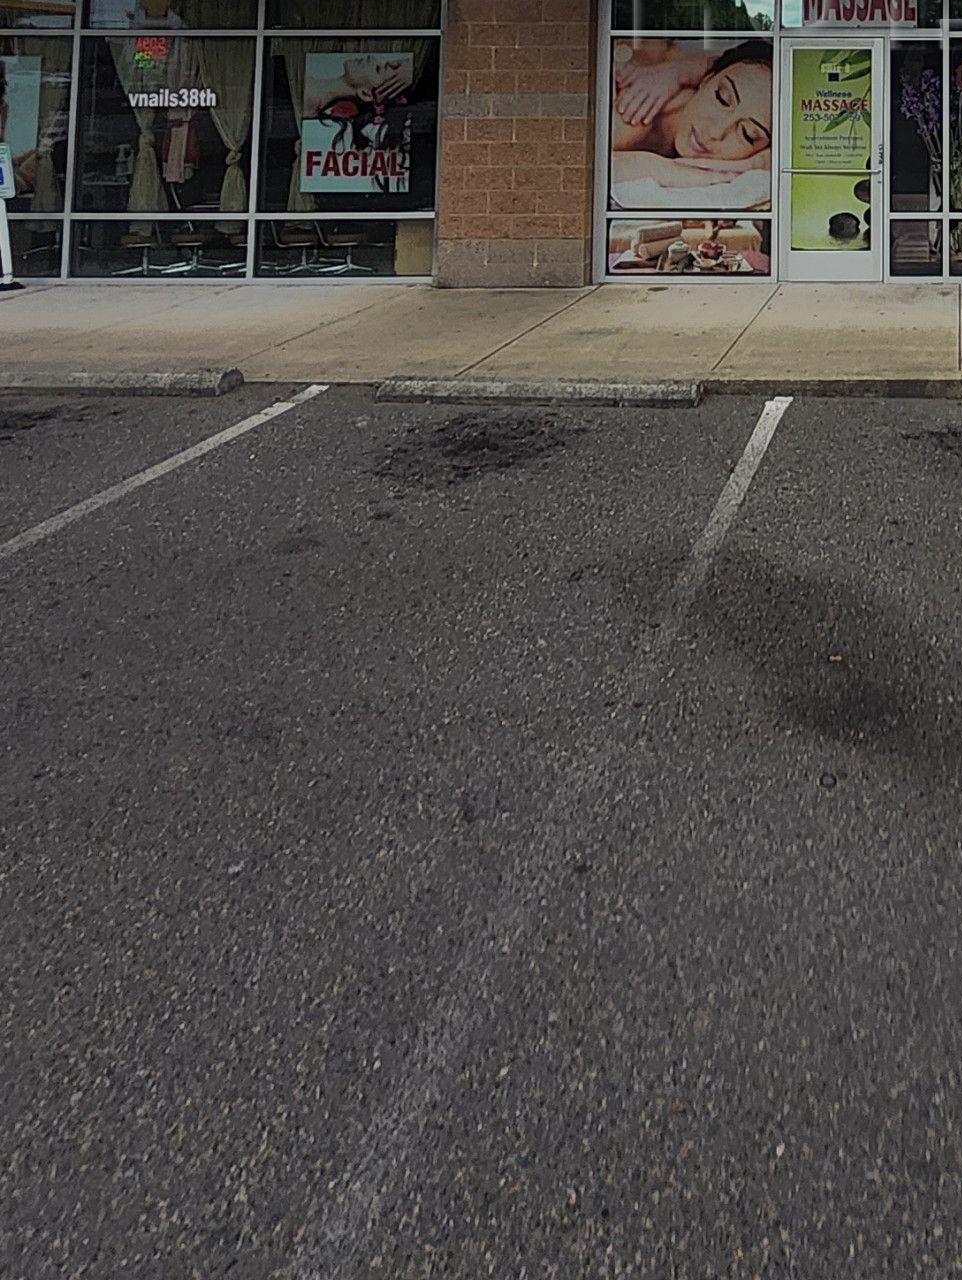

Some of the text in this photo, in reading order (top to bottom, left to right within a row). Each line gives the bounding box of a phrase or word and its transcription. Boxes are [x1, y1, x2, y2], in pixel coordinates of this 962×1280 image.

[128, 88, 217, 108] vnails38th
[801, 98, 869, 112] MASSAGE
[305, 150, 405, 177] FACIAL
